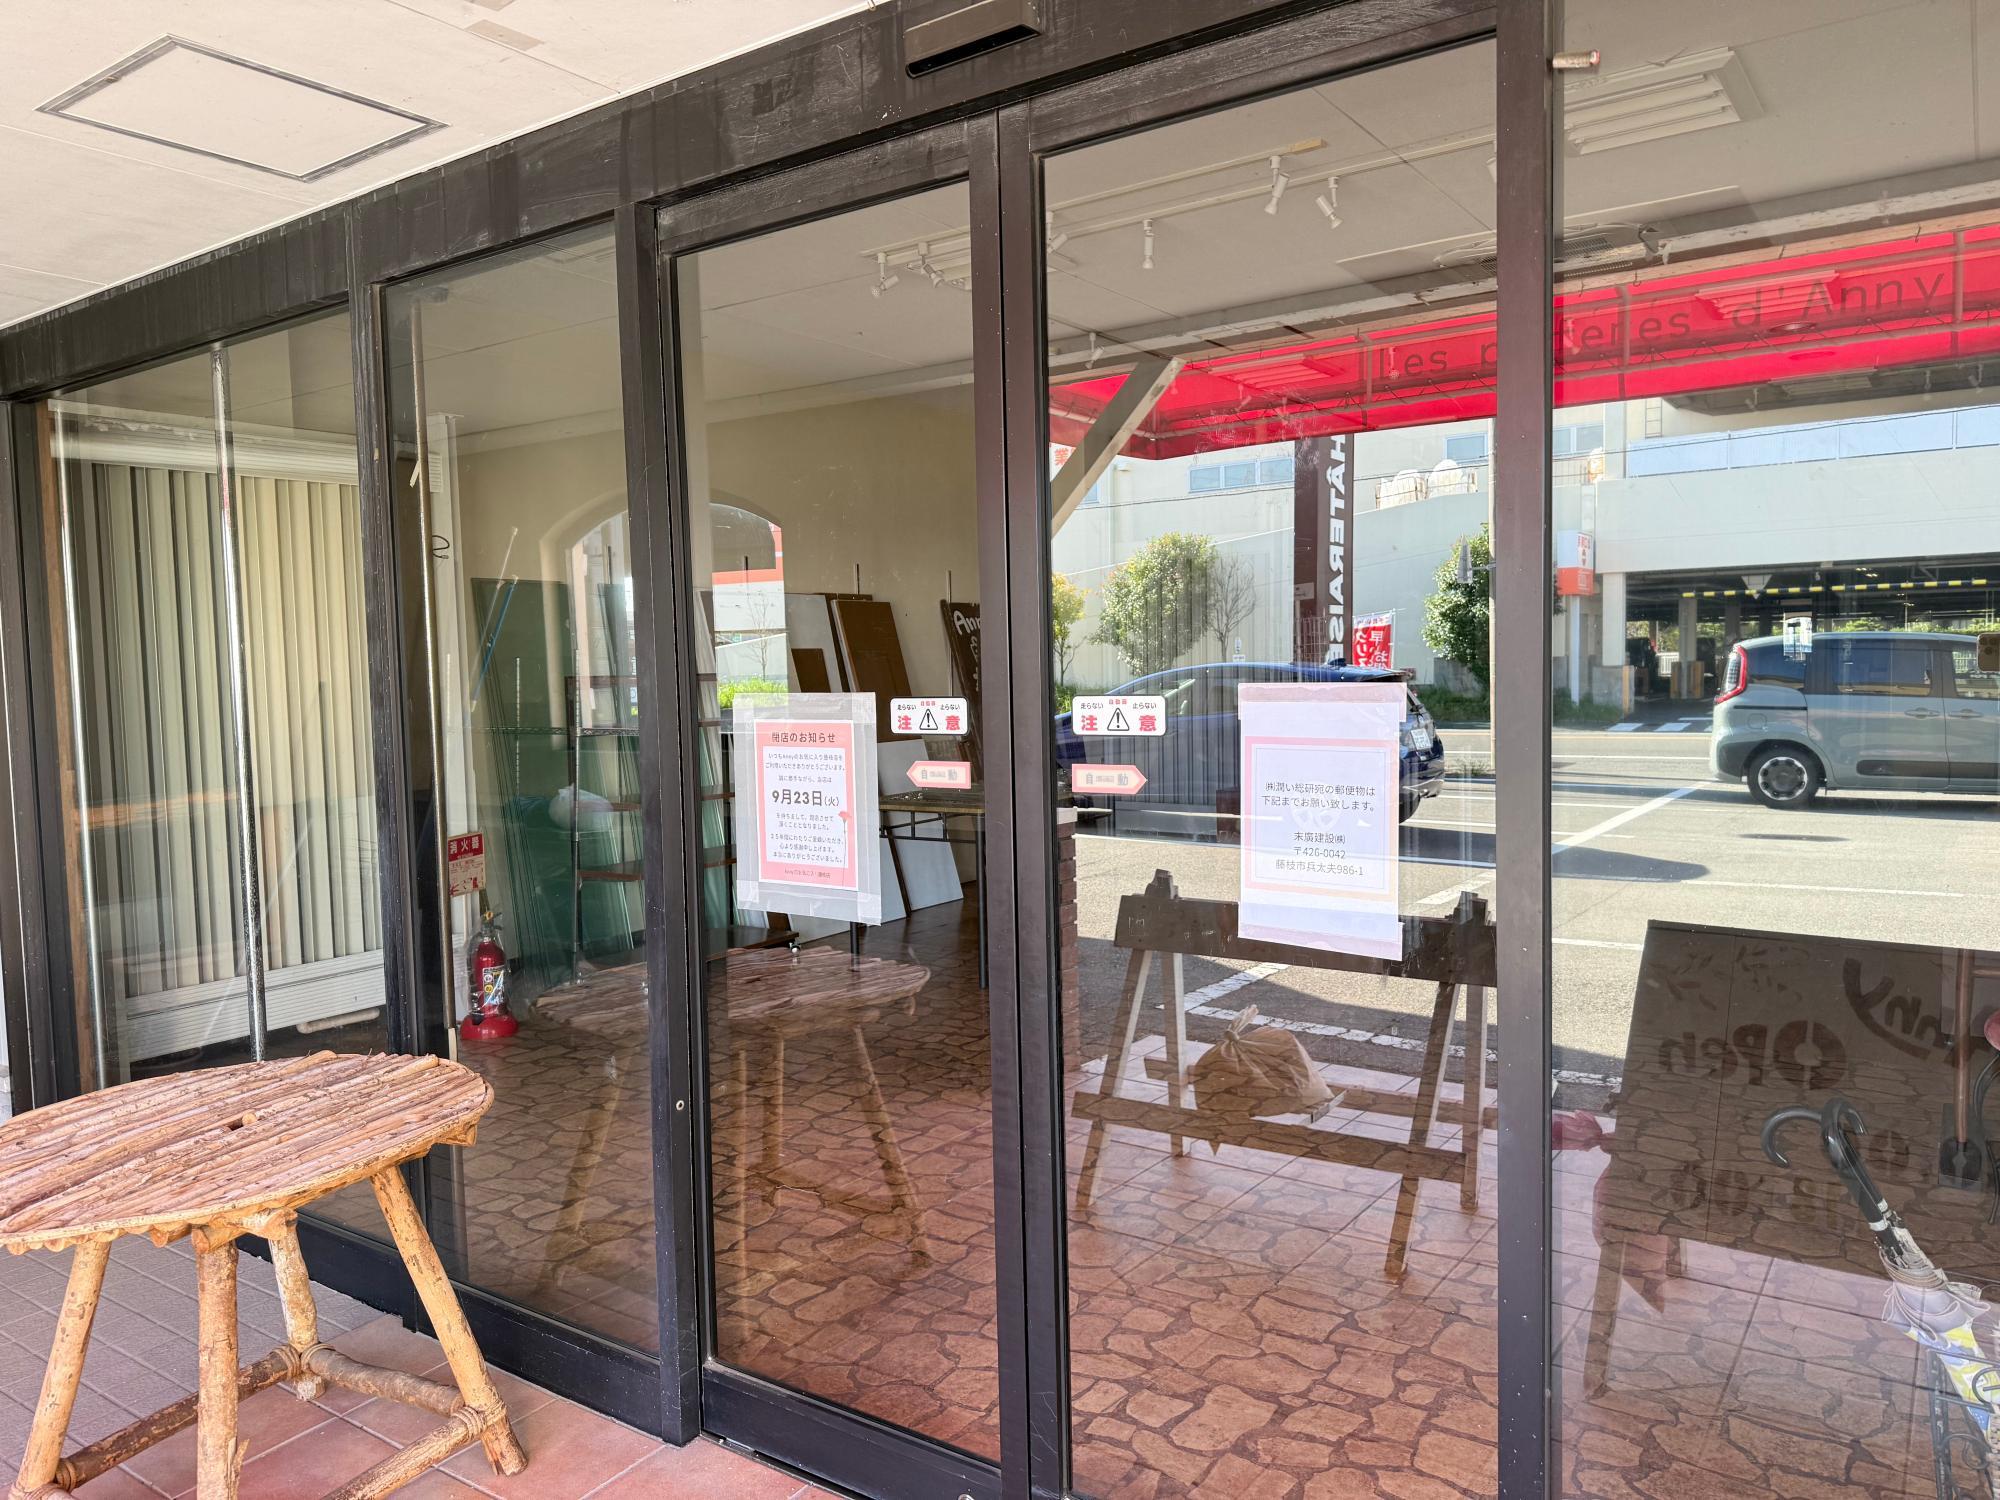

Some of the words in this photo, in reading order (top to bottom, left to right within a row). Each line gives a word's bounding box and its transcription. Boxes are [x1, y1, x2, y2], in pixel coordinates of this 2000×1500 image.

[771, 732, 836, 743] 閉店のお知らせ
[1261, 795, 1375, 812] 下記までお願い致します。
